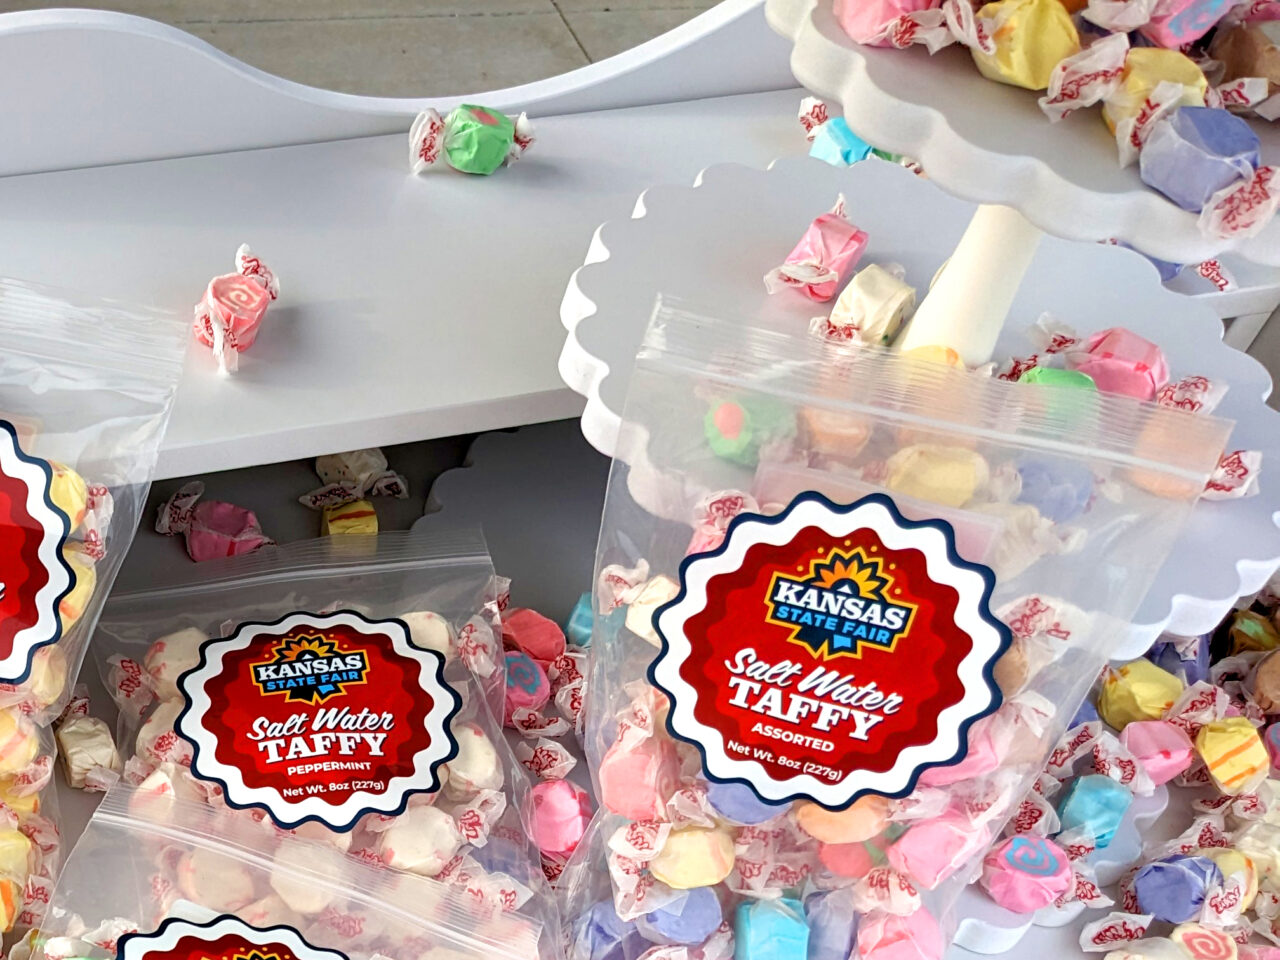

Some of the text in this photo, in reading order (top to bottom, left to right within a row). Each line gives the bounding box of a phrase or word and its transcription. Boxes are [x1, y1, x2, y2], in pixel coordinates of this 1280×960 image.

[774, 580, 906, 630] KANSAS
[776, 605, 890, 644] STATE FAIR
[256, 655, 363, 682] KANSAS
[266, 671, 359, 690] STATE FAIR
[724, 647, 904, 715] Salt Water
[246, 707, 394, 740] Salt Water
[728, 676, 884, 742] TAFFY
[258, 733, 387, 764] TAFFY
[751, 722, 835, 753] ASSORTED
[287, 762, 372, 776] PEPPERMINT
[727, 740, 843, 782] Net Wt. 8oz (227g)
[283, 780, 385, 798] Net Wt. 8oz (227g)
